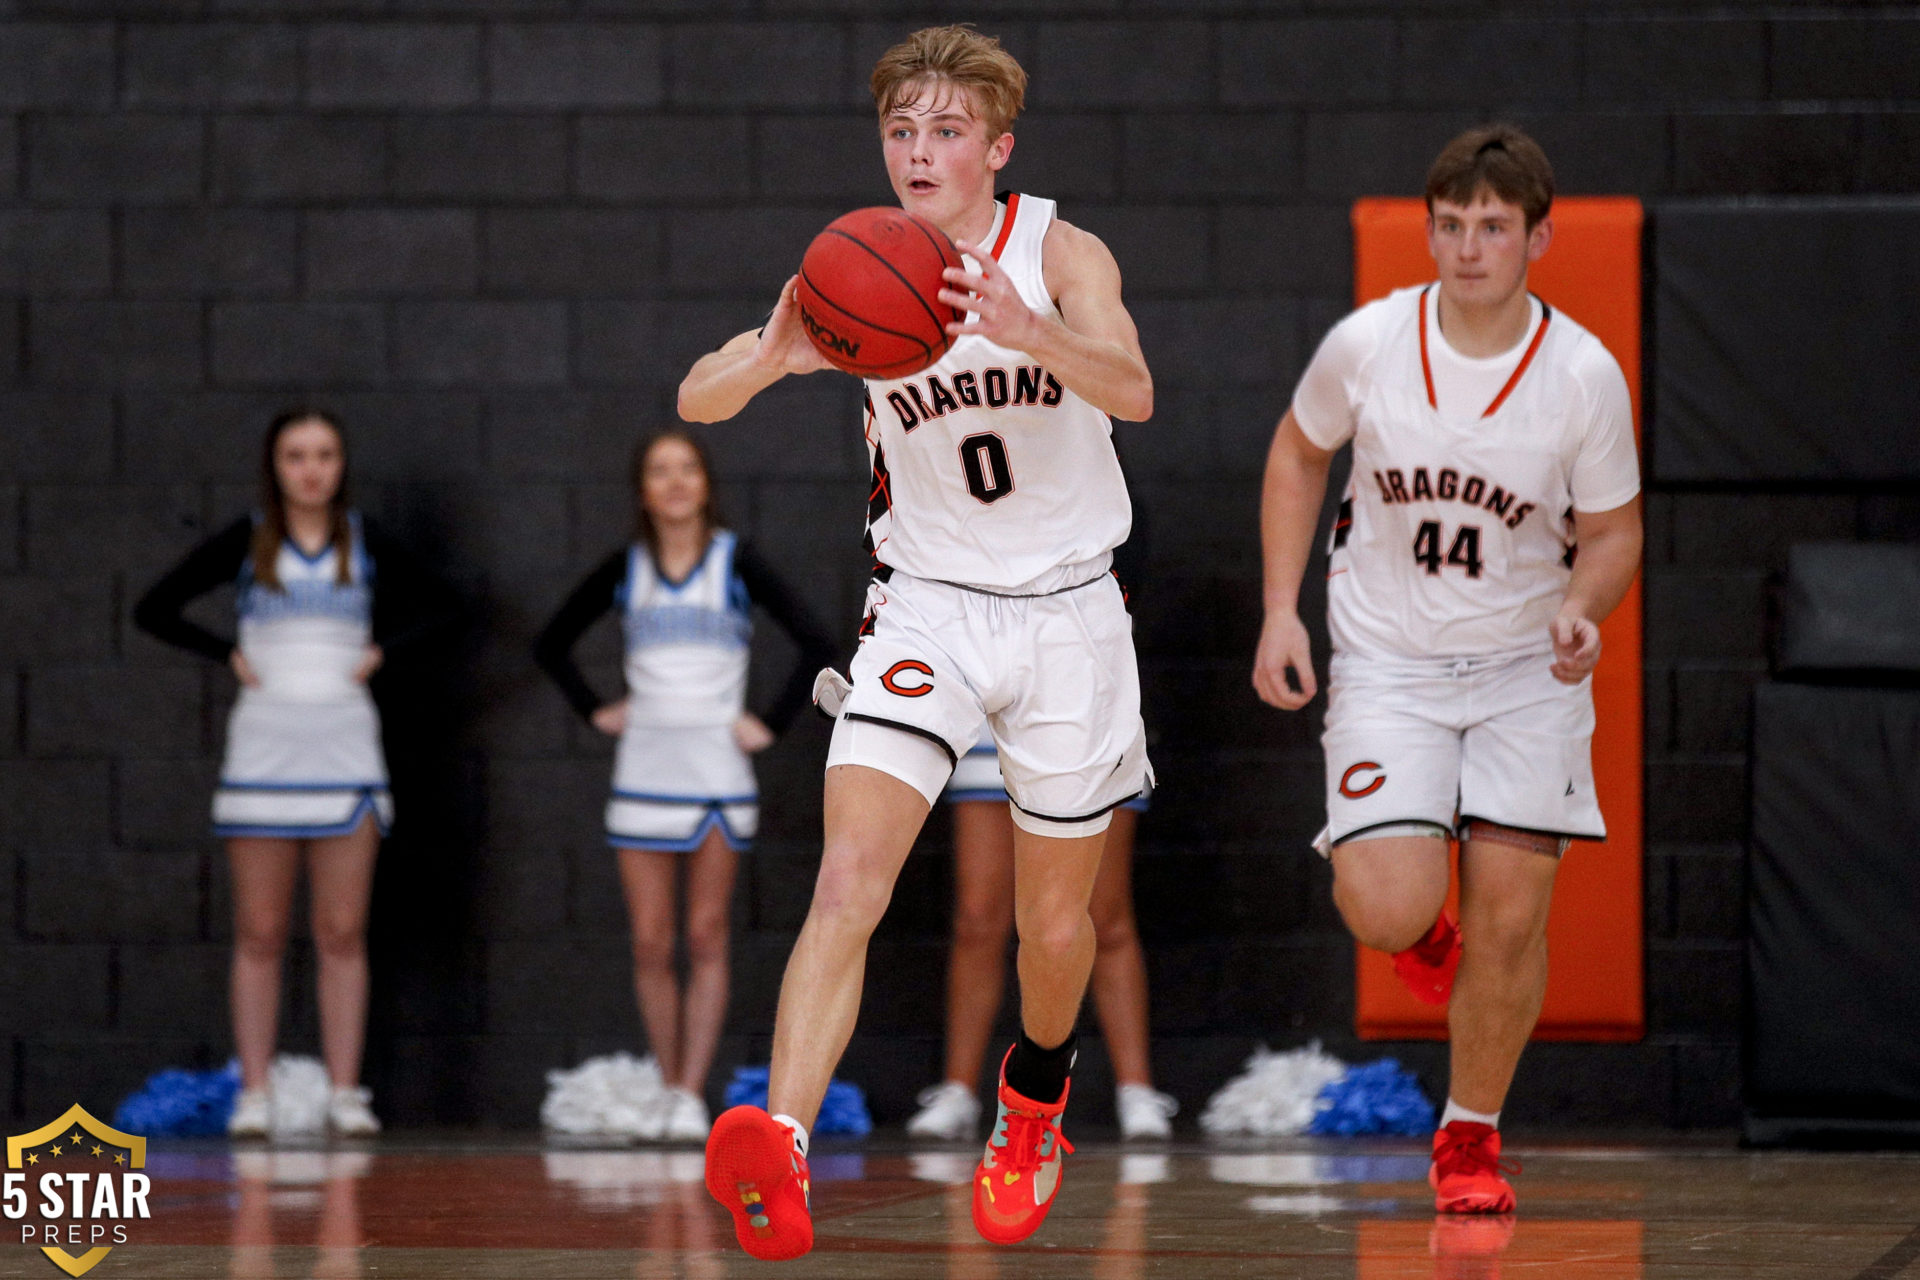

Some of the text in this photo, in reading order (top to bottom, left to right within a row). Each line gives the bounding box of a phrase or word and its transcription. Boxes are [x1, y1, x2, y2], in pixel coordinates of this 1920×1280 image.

[886, 365, 1065, 434] DRAGONS
[957, 430, 1016, 505] 0
[1413, 519, 1484, 580] 44
[878, 659, 935, 698] C
[1338, 761, 1387, 800] C
